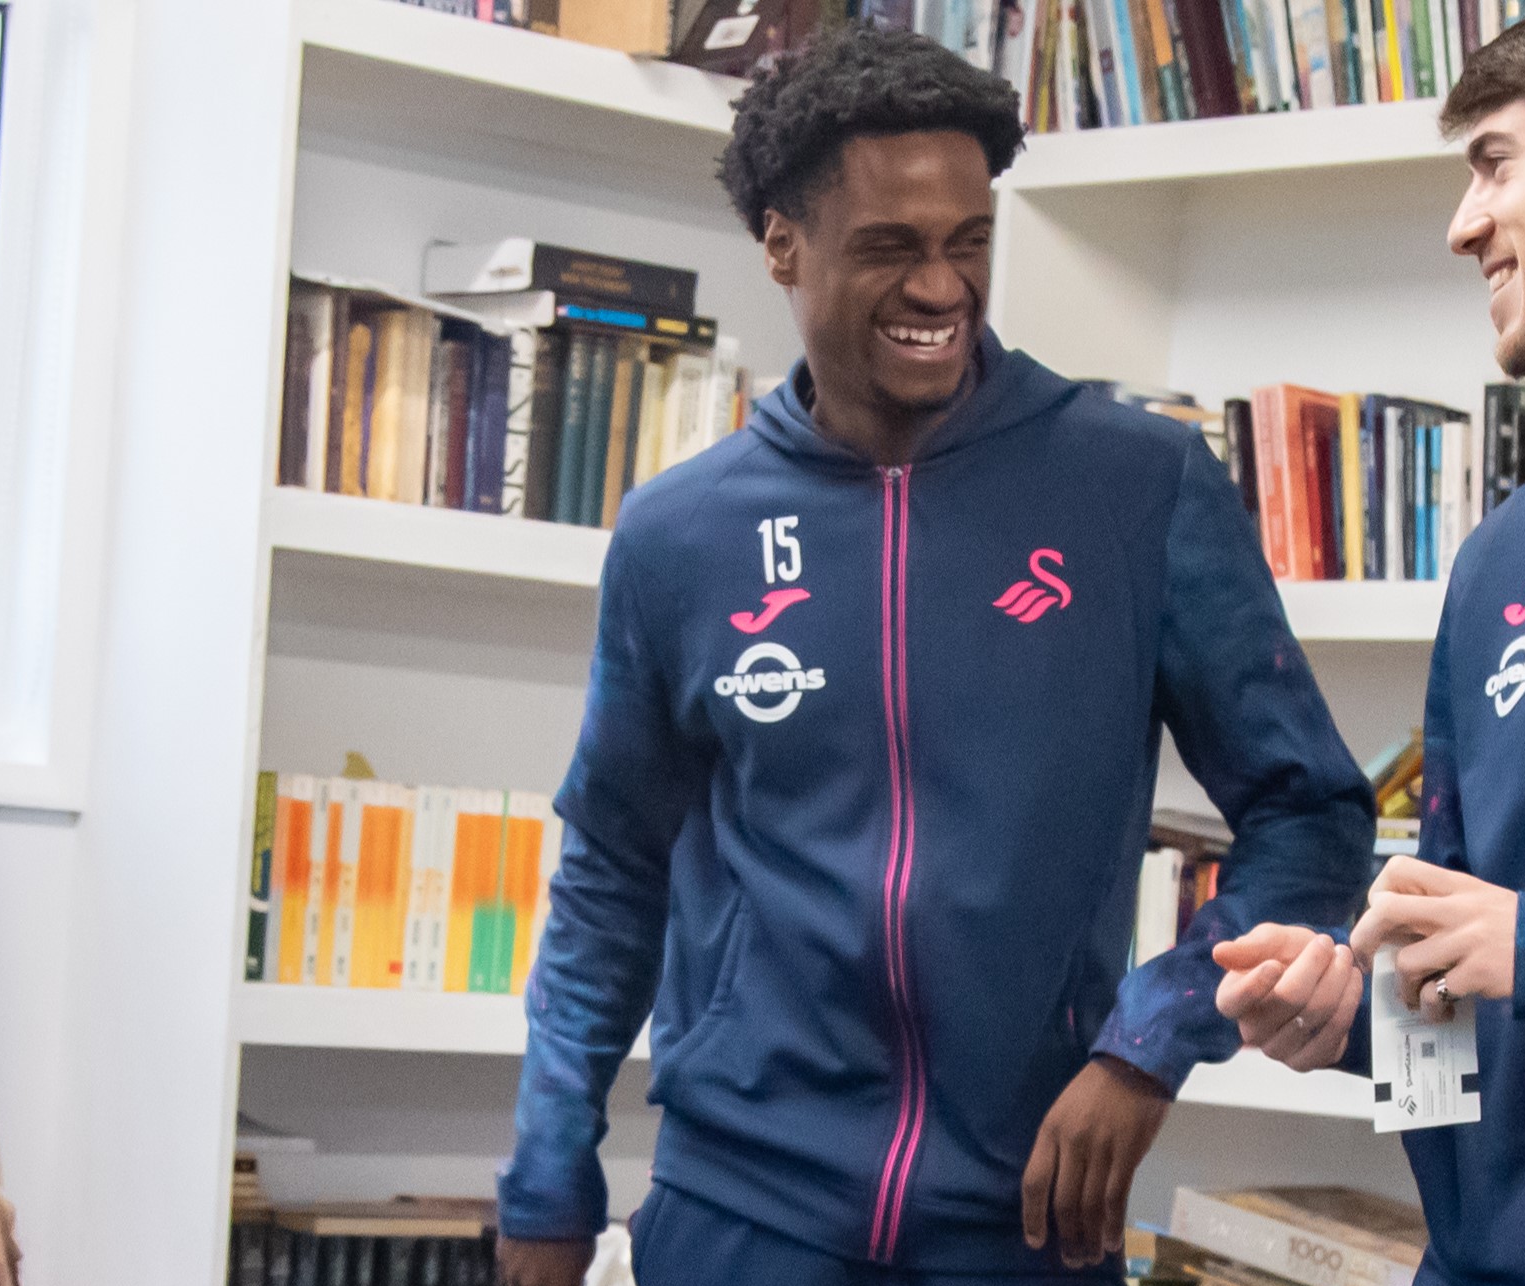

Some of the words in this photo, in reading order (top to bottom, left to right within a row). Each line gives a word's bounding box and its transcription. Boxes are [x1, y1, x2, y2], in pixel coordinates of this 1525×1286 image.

[757, 515, 802, 584] 15
[714, 666, 826, 697] owens
[1288, 1236, 1343, 1271] 1000
